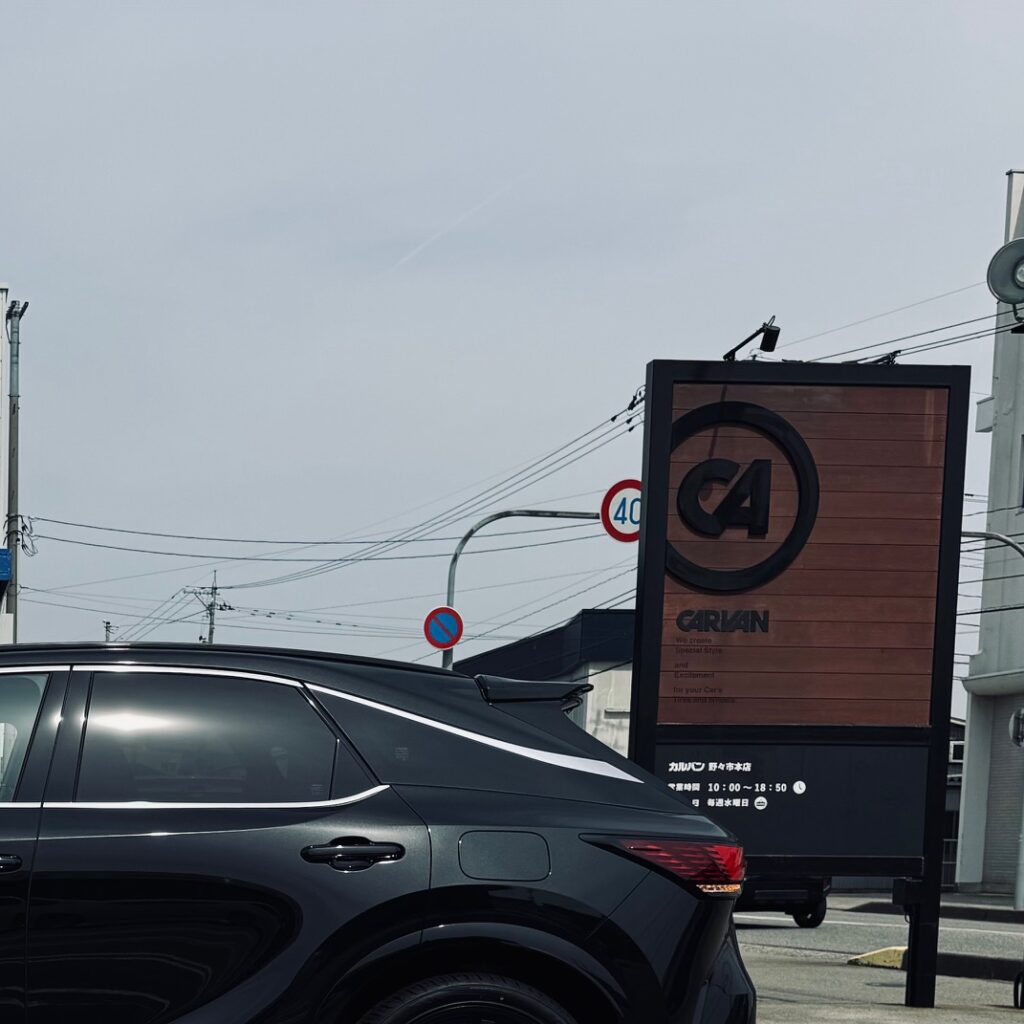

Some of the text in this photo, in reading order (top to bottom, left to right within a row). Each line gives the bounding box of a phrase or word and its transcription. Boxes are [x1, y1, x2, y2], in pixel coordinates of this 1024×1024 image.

[613, 497, 641, 525] 40
[676, 609, 770, 633] CARVAN
[708, 762, 752, 772] 野々市本店
[707, 798, 750, 807] 毎週水曜日
